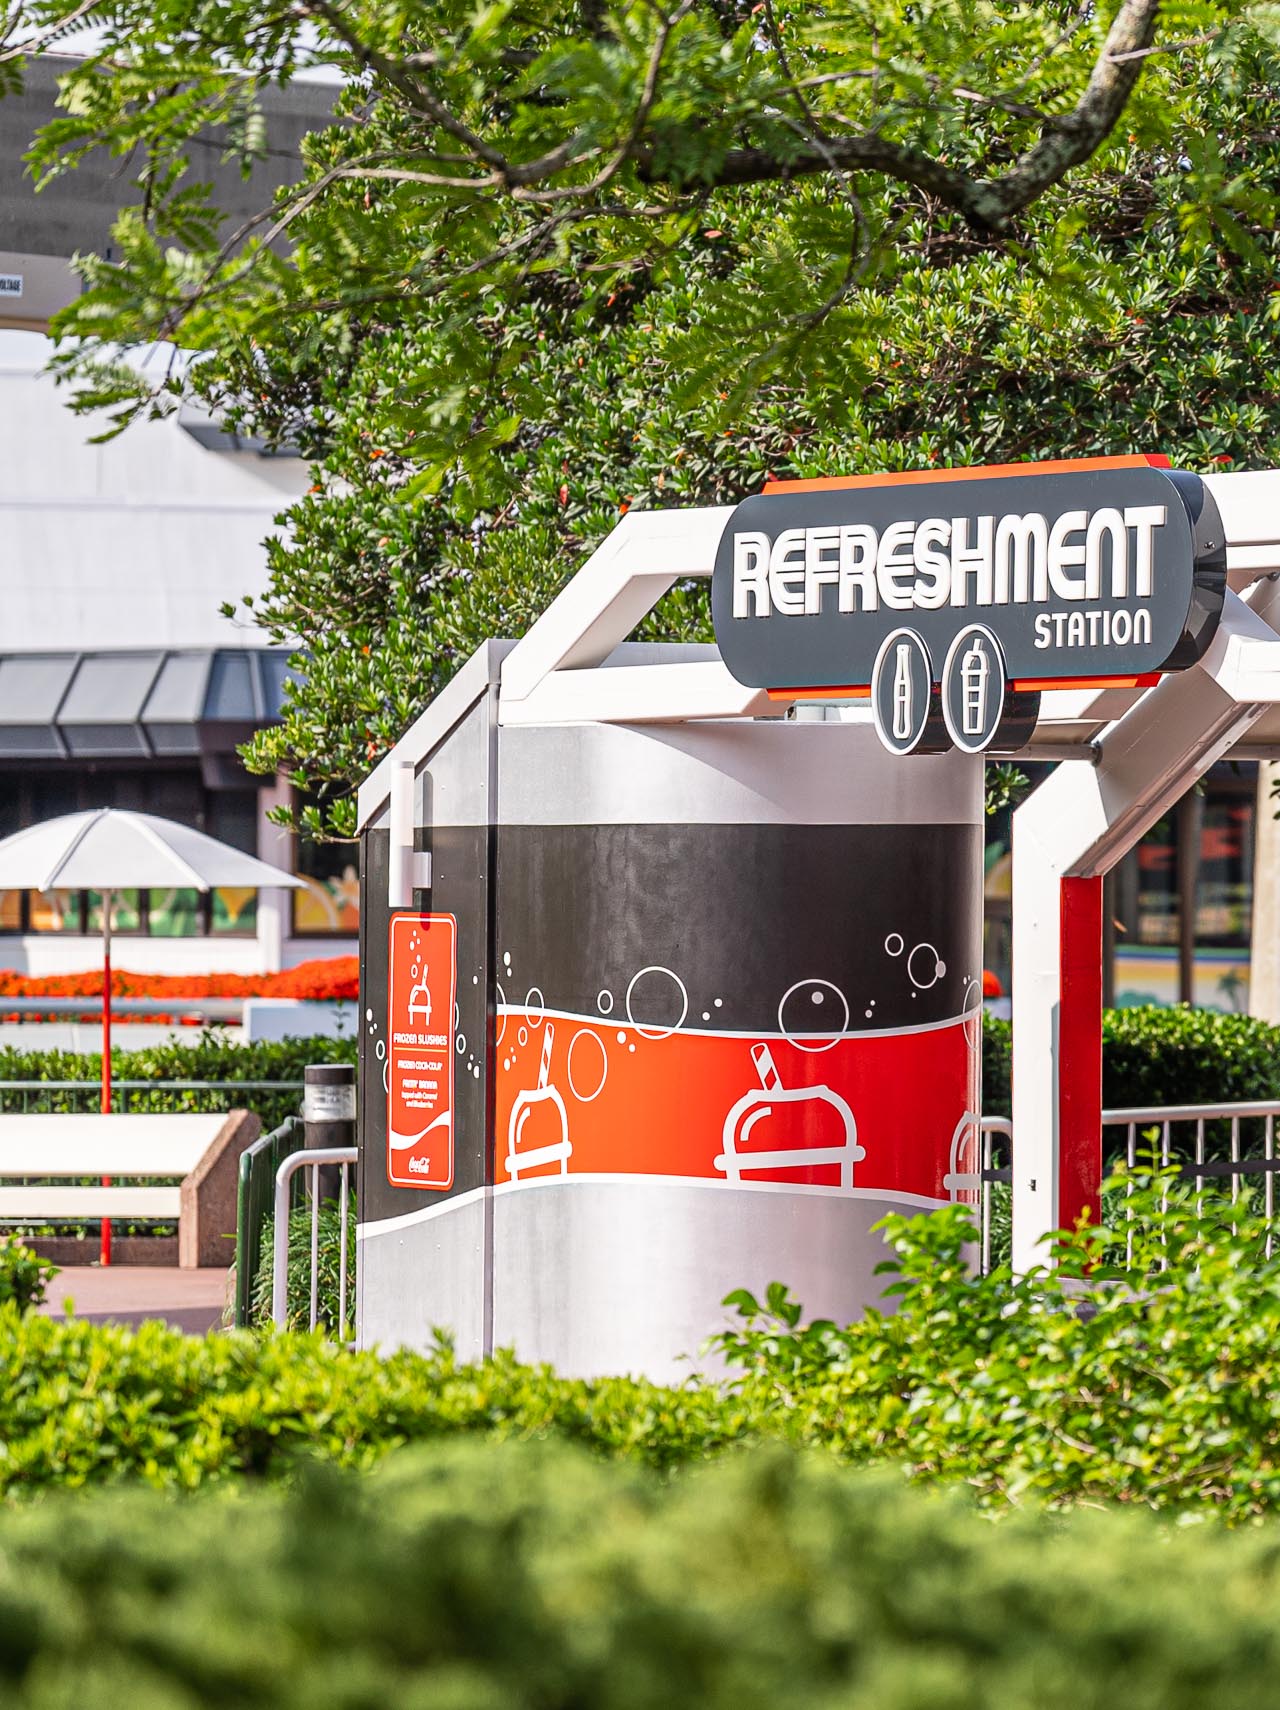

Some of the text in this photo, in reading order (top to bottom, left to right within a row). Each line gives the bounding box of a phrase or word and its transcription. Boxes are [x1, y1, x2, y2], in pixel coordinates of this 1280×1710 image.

[732, 505, 1168, 619] REFRESHMENT
[1034, 608, 1152, 650] STATION
[393, 1032, 448, 1046] FROZEN SLUSHIES
